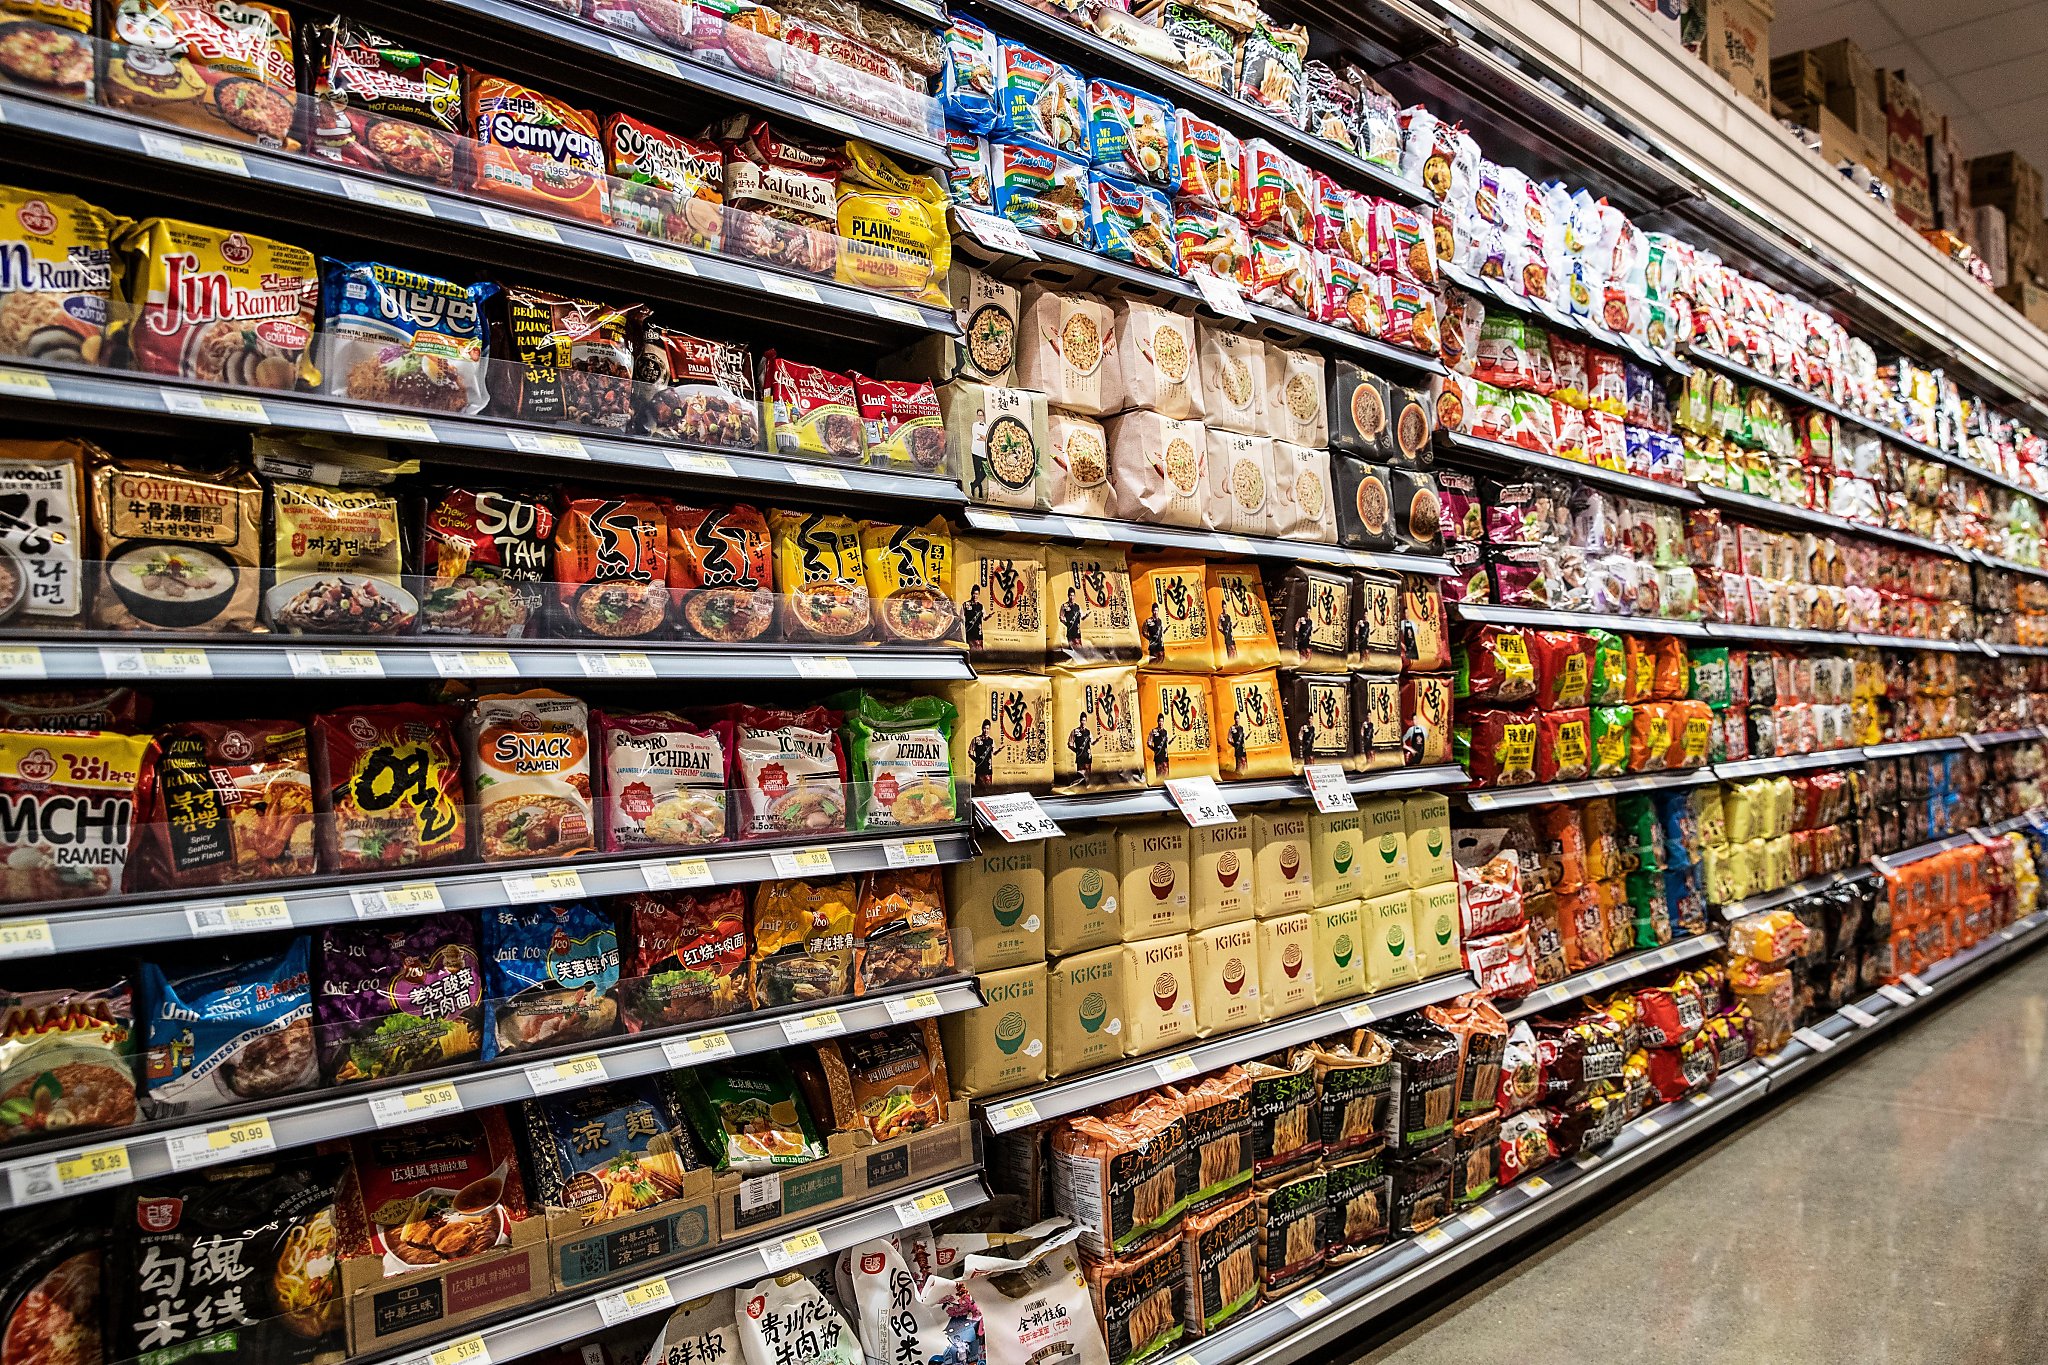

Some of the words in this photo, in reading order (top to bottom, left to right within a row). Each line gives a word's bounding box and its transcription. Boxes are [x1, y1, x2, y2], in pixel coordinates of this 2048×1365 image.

[392, 55, 410, 64] TYPE
[369, 102, 387, 112] HOT
[388, 103, 414, 114] Chicken
[495, 116, 604, 166] Samyang
[1014, 152, 1054, 171] Indomie
[549, 166, 569, 177] 1963
[1173, 164, 1180, 177] 5
[757, 171, 782, 194] Kal
[784, 177, 811, 201] Guk
[812, 186, 827, 205] Su
[1012, 175, 1032, 186] Instant
[852, 219, 893, 242] PLAIN
[848, 239, 895, 261] INSTANT
[992, 233, 1030, 250] $1.49
[39, 262, 110, 290] Ramen
[856, 258, 900, 278] 라면사리
[261, 273, 302, 292] 진라면
[374, 266, 429, 290] BIBIM
[432, 282, 469, 300] MEN
[151, 255, 233, 330] Jin
[84, 297, 106, 311] MILD
[236, 291, 297, 316] Ramen
[379, 283, 478, 334] 비빔면
[513, 306, 550, 320] BEIJING
[272, 323, 297, 335] SPICY
[514, 321, 551, 333] JJAJANG
[378, 333, 400, 344] NOODLE
[688, 363, 710, 374] PALDO
[862, 393, 887, 406] Unif
[3, 470, 63, 481] NOODLE
[298, 467, 313, 477] 580
[120, 480, 230, 507] GOMTANG
[281, 489, 393, 511] JJAJANGMEN
[435, 501, 468, 519] Chewy
[475, 492, 536, 536] SU
[438, 516, 473, 531] Chewy
[307, 536, 360, 558] 짜장면
[494, 536, 546, 569] TAH
[502, 568, 543, 583] RAMEN
[174, 654, 201, 667] $1.49
[348, 655, 374, 668] $1.49
[487, 655, 509, 668] $1.49
[495, 734, 573, 763] SNACK
[616, 734, 668, 751] SAPPORO
[648, 750, 711, 770] ICHIBAN
[895, 743, 941, 760] ICHIBAN
[62, 754, 137, 785] 김치라면
[515, 760, 561, 773] RAMEN
[911, 759, 935, 768] CHICKEN
[674, 768, 701, 777] SHRIMP
[170, 790, 216, 813] 북경
[1328, 792, 1353, 806] $8.49
[626, 804, 651, 813] ICHIBAN
[1199, 804, 1230, 819] $8.49
[1372, 809, 1394, 825] KiKi
[0, 795, 131, 846] MCHI
[173, 810, 221, 835] 짬뽕
[1016, 819, 1055, 835] $8.49
[1273, 820, 1297, 836] KiKi
[614, 826, 631, 834] NET
[1211, 827, 1238, 844] KiKi
[188, 841, 218, 854] Seafood
[190, 833, 213, 846] Spicy
[1142, 836, 1171, 852] KiKi
[56, 847, 127, 866] RAMEN
[181, 854, 202, 866] Stew
[201, 849, 226, 863] Flavor
[811, 853, 828, 864] $0.99
[1069, 841, 1099, 861] KiKi
[687, 865, 706, 875] $0.99
[983, 854, 1020, 875] KiKi
[551, 876, 577, 889] $1.49
[410, 888, 435, 902] $1.49
[253, 904, 282, 918] $1.49
[643, 901, 666, 915] 100
[1276, 919, 1300, 937] KiKi
[1326, 911, 1350, 929] KiKi
[2, 929, 42, 944] $1.49
[809, 932, 854, 954] 清炖排骨
[1215, 932, 1242, 951] KiKi
[522, 946, 541, 960] 100
[683, 931, 745, 966] 红烧牛肉面
[1145, 945, 1174, 965] KiKi
[1070, 965, 1101, 985] KiKi
[409, 968, 475, 1005] 老坛酸菜
[986, 982, 1022, 1004] KiKi
[422, 989, 472, 1020] 牛肉面
[916, 995, 937, 1008] $0.99
[816, 1013, 838, 1027] $0.99
[191, 1041, 240, 1080] CHINESE
[241, 1020, 282, 1042] ONION
[703, 1036, 727, 1050] $0.99
[572, 1060, 599, 1075] $0.99
[1406, 1078, 1433, 1094] A-SHA
[424, 1090, 453, 1106] $0.99
[1320, 1088, 1355, 1104] A-SHA
[1250, 1100, 1285, 1120] A-SHA
[230, 1127, 264, 1145] $0.99
[91, 1155, 122, 1172] $0.39
[1255, 1162, 1263, 1174] 5
[391, 1166, 428, 1183] 広東風
[1108, 1170, 1146, 1197] A-SHA
[930, 1194, 947, 1207] $1.99
[1265, 1207, 1297, 1229] A-SHA
[802, 1235, 820, 1248] $1.99
[140, 1234, 255, 1298] 勾魂
[1199, 1248, 1228, 1274] A-SHA
[646, 1284, 666, 1299] $1.99
[1104, 1295, 1142, 1321] A-SHA
[133, 1285, 259, 1351] 米线
[457, 1342, 482, 1358] $1.99
[667, 1332, 728, 1365] 鲜椒
